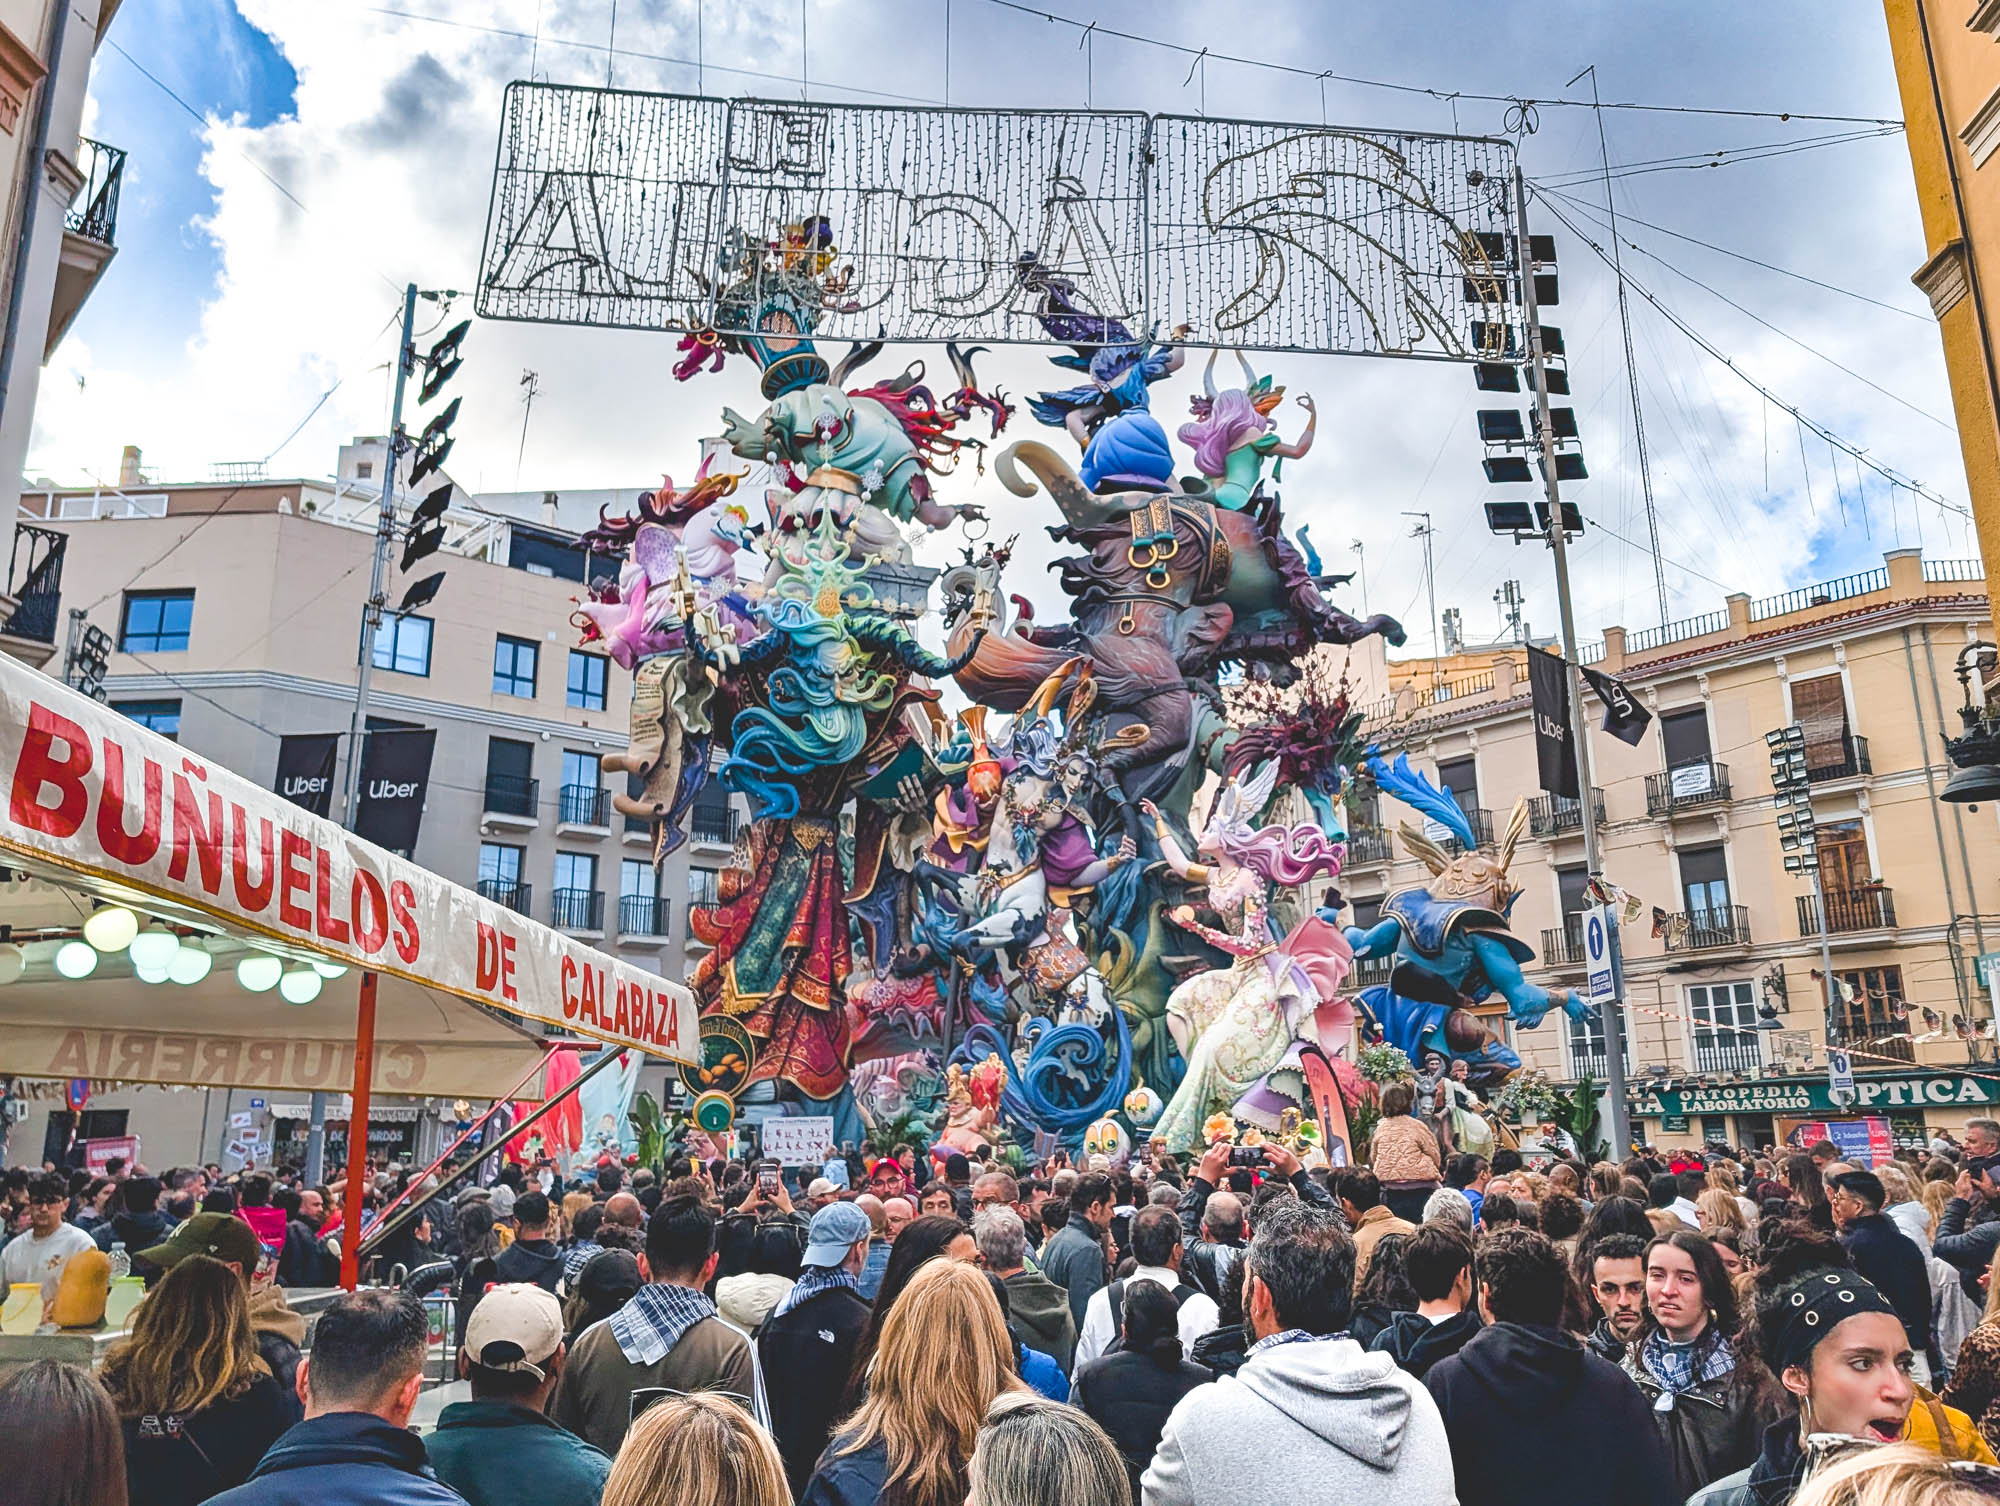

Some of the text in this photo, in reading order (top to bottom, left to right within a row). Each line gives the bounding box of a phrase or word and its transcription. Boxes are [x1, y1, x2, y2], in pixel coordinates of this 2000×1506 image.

[284, 776, 328, 796] Uber
[369, 780, 419, 799] Uber
[9, 701, 680, 1050] BUÑUELOS DE CALABAZA
[1679, 1085, 1810, 1101] ORTOPEDIA
[1680, 1097, 1811, 1113] LABORATORIO
